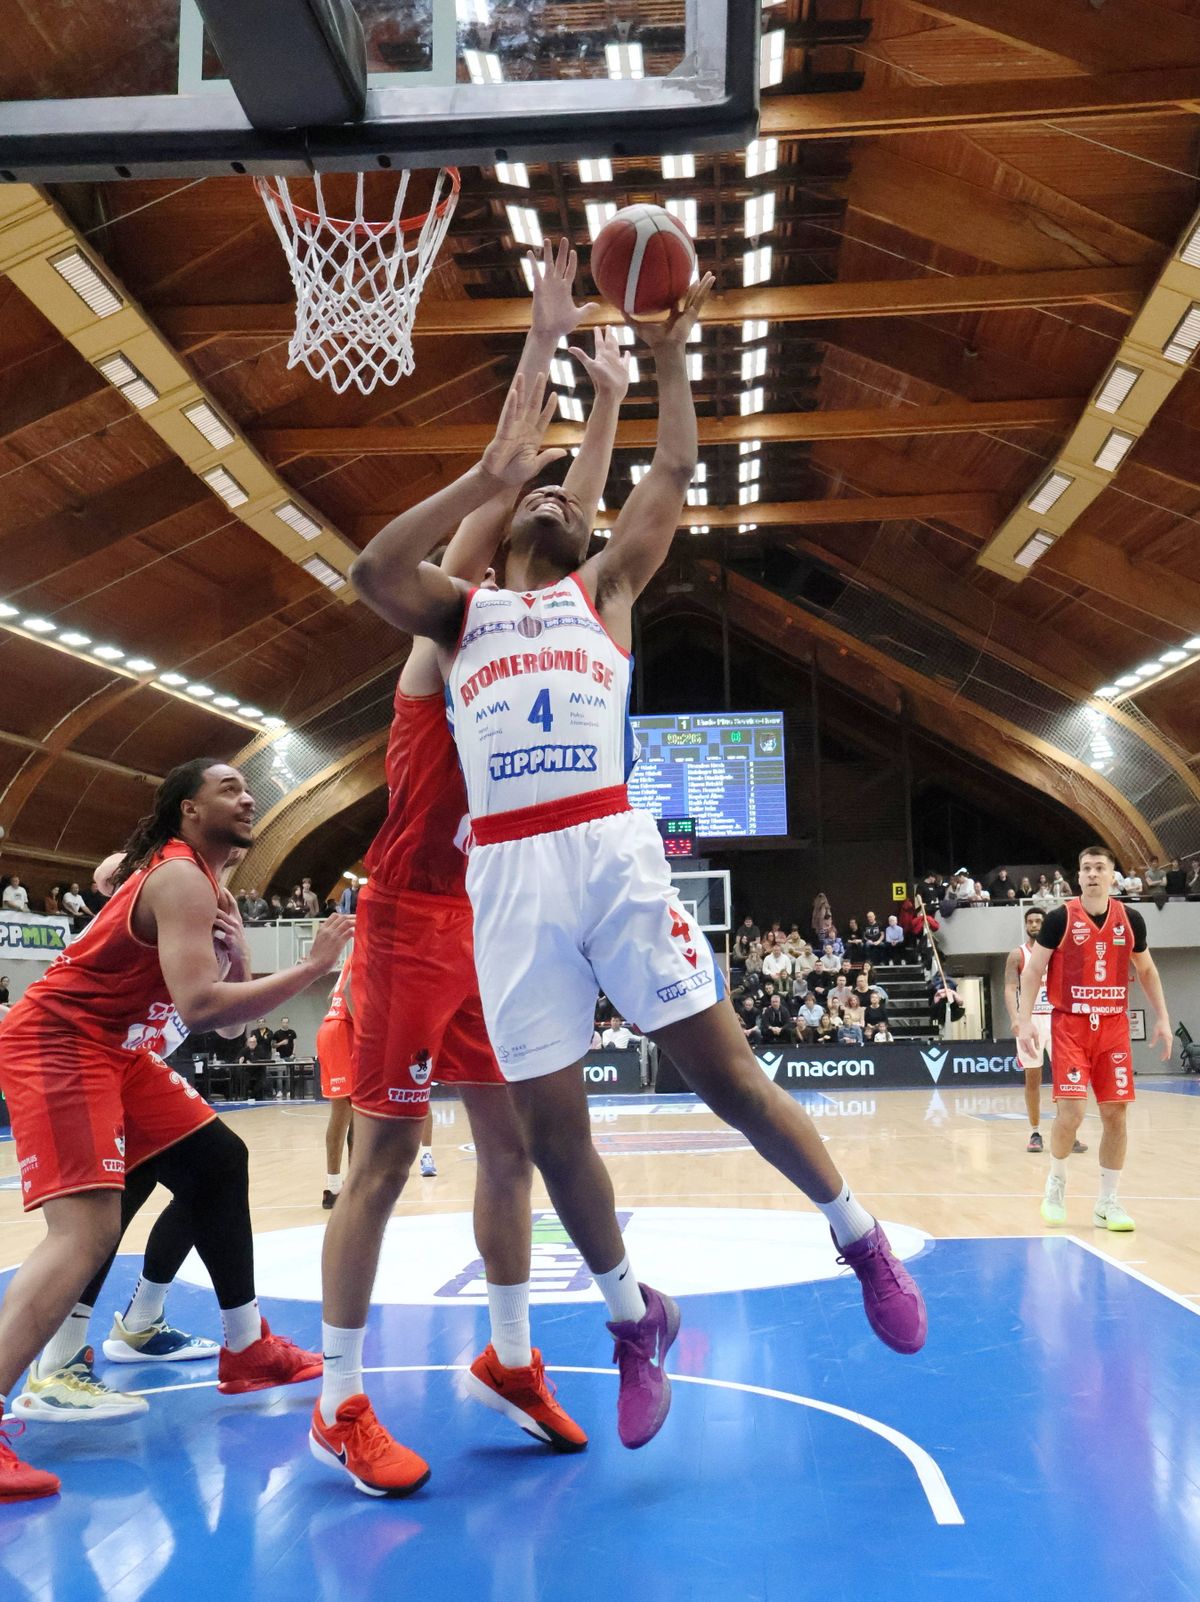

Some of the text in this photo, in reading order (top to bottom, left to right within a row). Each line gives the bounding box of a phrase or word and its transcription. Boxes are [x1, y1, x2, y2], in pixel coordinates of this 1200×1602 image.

[460, 646, 615, 707] ATOMERŐMŰ SE
[475, 700, 510, 723] MVM
[527, 688, 553, 733] 4
[569, 692, 607, 710] MVM
[681, 719, 687, 730] 1
[895, 886, 904, 895] B
[1095, 960, 1107, 982] 5
[787, 1060, 875, 1077] macron
[1115, 1066, 1128, 1088] 5
